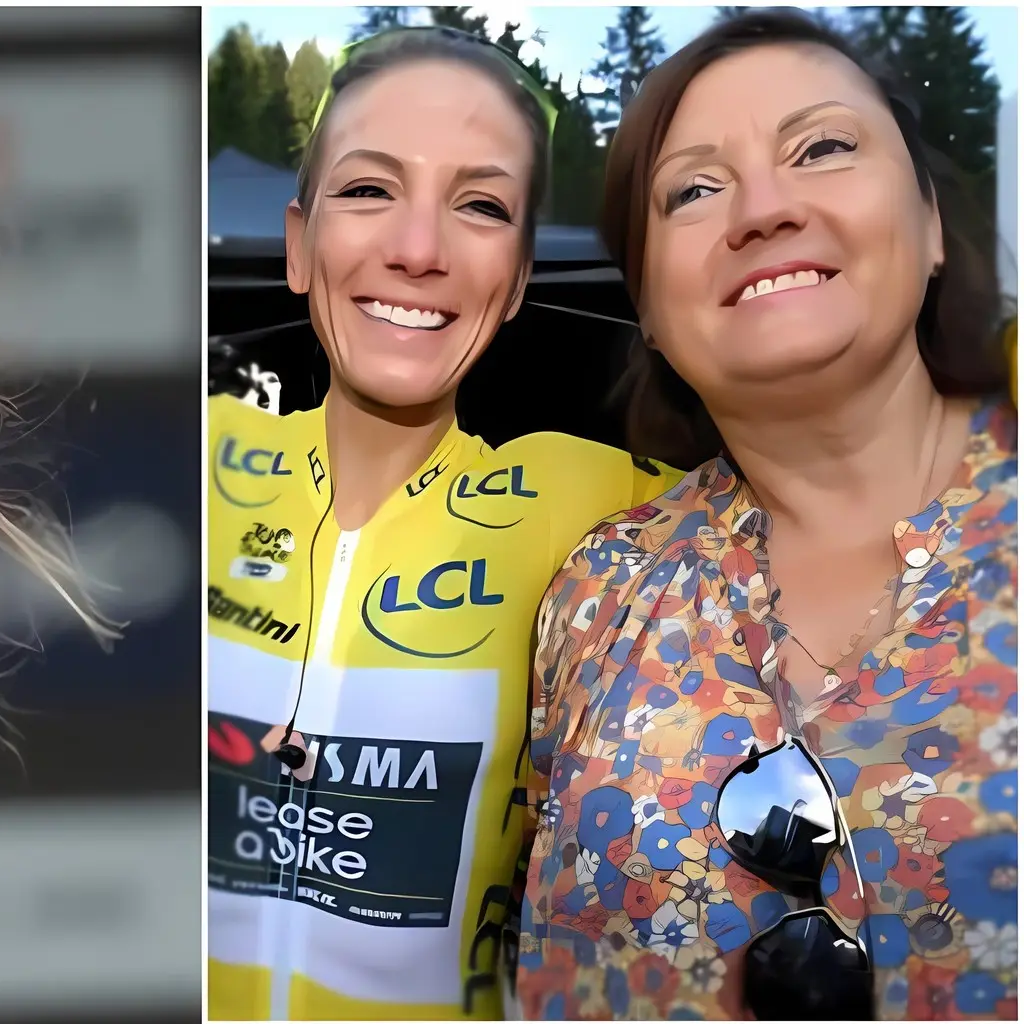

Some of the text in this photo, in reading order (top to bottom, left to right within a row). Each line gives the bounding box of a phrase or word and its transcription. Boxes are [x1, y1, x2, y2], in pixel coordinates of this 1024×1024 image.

[220, 436, 293, 476] LCL
[456, 464, 539, 499] LCL
[379, 558, 505, 613] LCL
[280, 738, 439, 790] ISMA
[237, 784, 374, 840] lease
[234, 830, 264, 861] a
